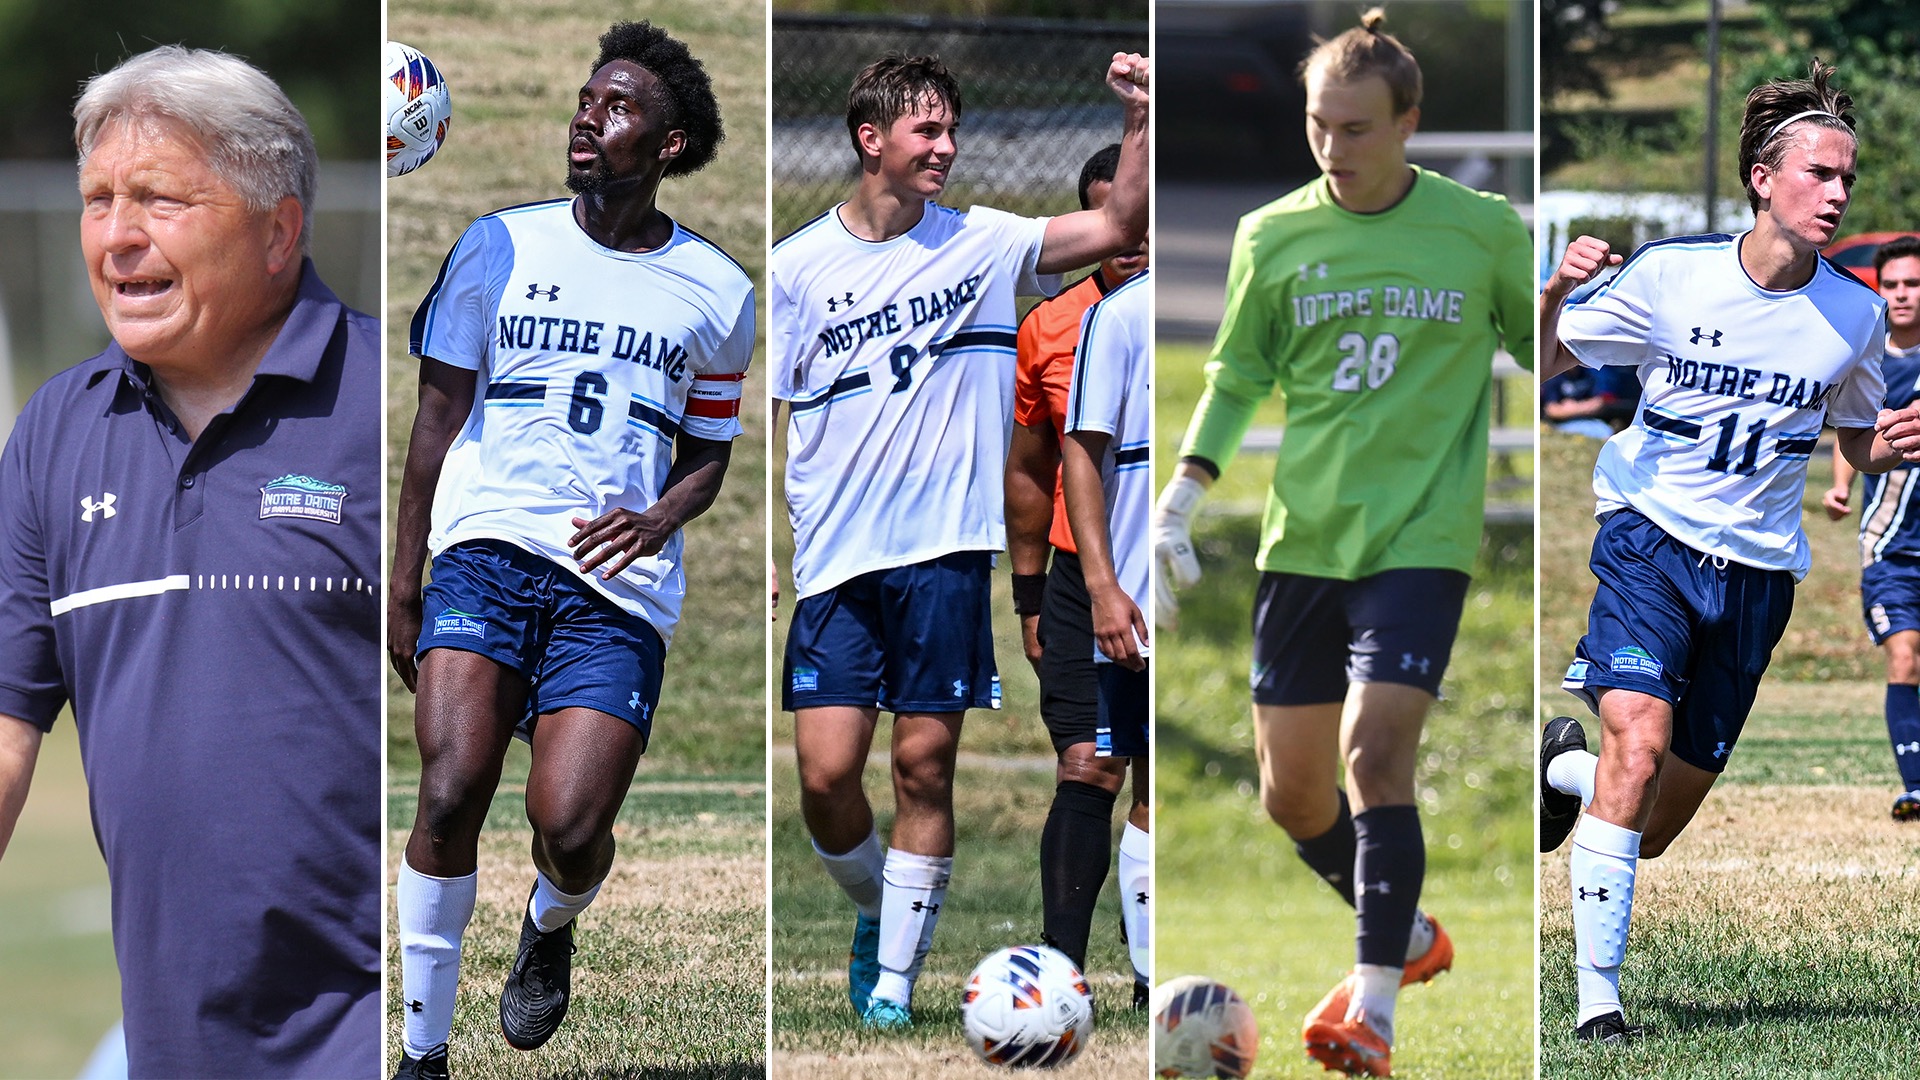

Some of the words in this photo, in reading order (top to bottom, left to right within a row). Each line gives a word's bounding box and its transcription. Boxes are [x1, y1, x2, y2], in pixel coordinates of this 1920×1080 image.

[404, 100, 423, 117] NCAA
[818, 303, 901, 358] NOTRE
[908, 274, 980, 328] DAME
[1384, 286, 1465, 324] DAME
[498, 315, 605, 356] NOTRE
[612, 325, 690, 384] DAME
[889, 343, 918, 394] 9
[1331, 331, 1399, 391] 28
[566, 369, 609, 436] 6
[1665, 353, 1763, 400] NOTRE
[1765, 372, 1838, 411] DAM
[1705, 411, 1768, 477] 11
[264, 493, 302, 506] NOTRE
[305, 494, 339, 511] DAME
[437, 618, 460, 627] NOTRE
[462, 618, 483, 632] DAME
[1614, 657, 1639, 665] NOTRE
[1640, 658, 1661, 672] DAME
